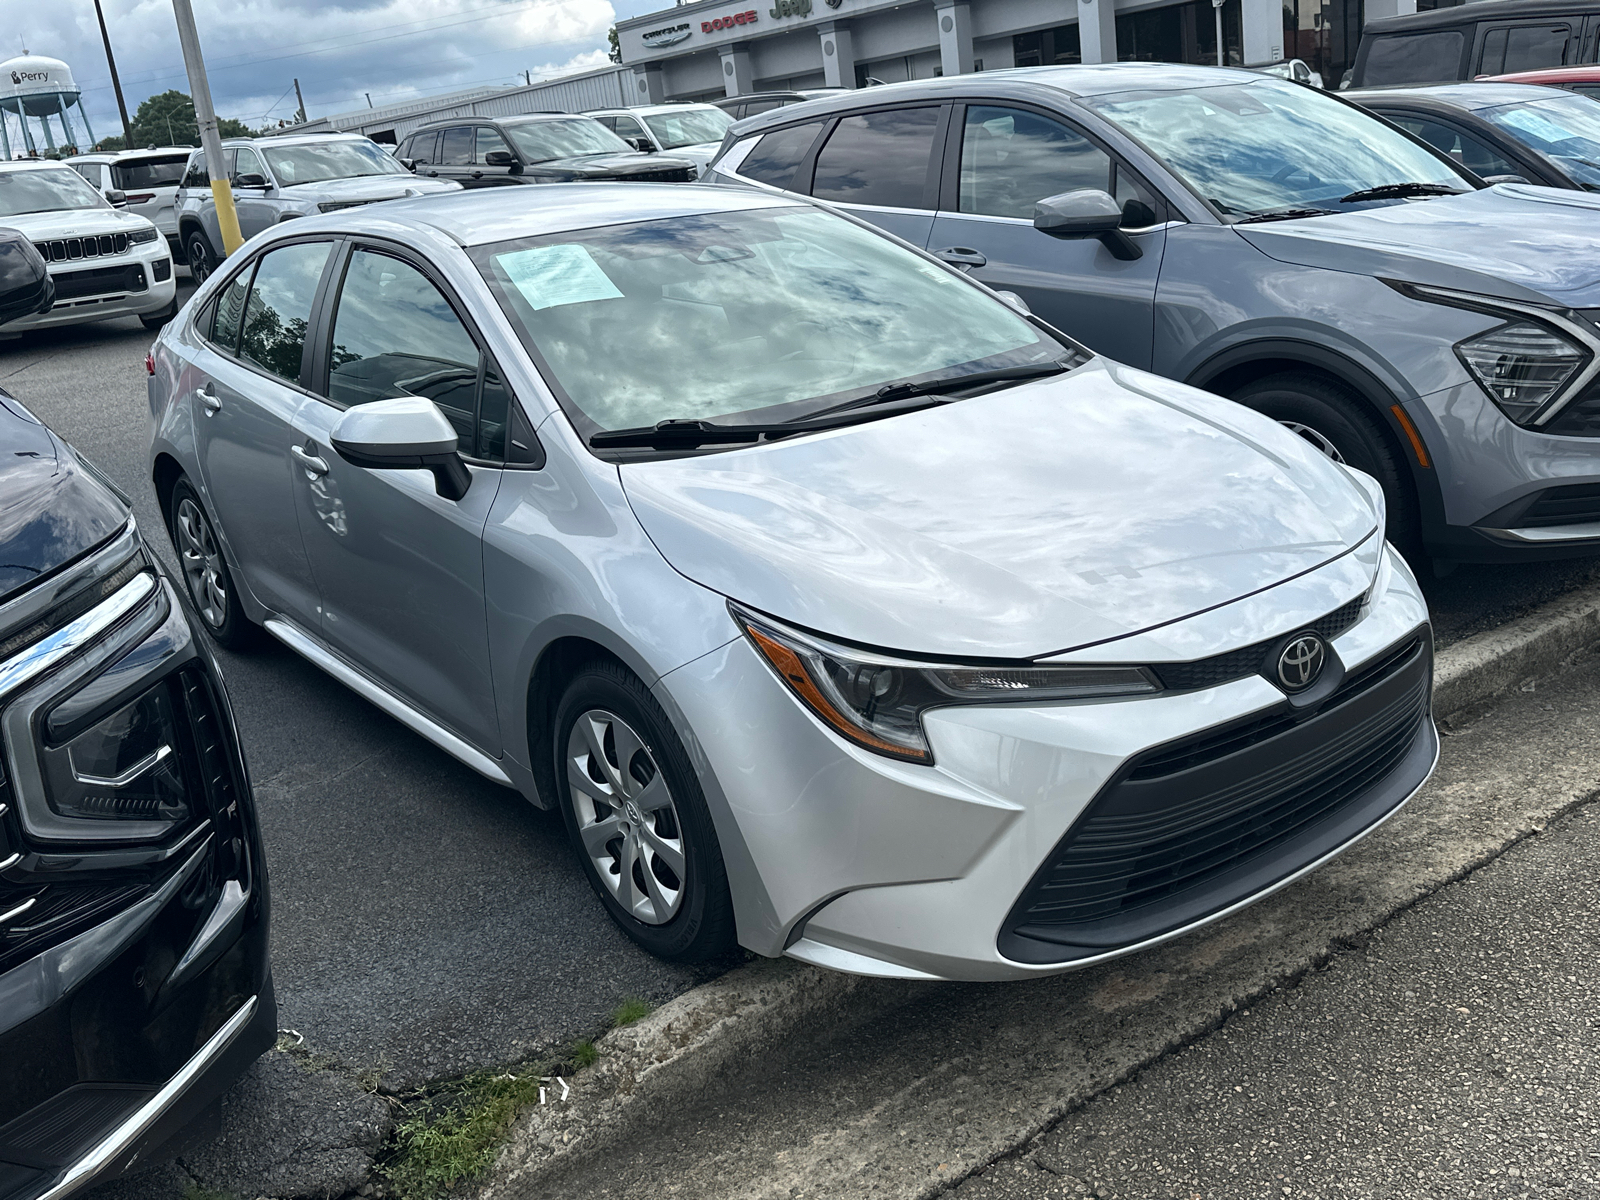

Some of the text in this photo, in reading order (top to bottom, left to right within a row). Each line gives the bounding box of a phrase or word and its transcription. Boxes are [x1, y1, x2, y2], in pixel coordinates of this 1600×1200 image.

[769, 0, 812, 19] Jeep
[701, 10, 757, 33] DODGE
[642, 23, 690, 40] CHRYSLER
[20, 71, 49, 82] Perry
